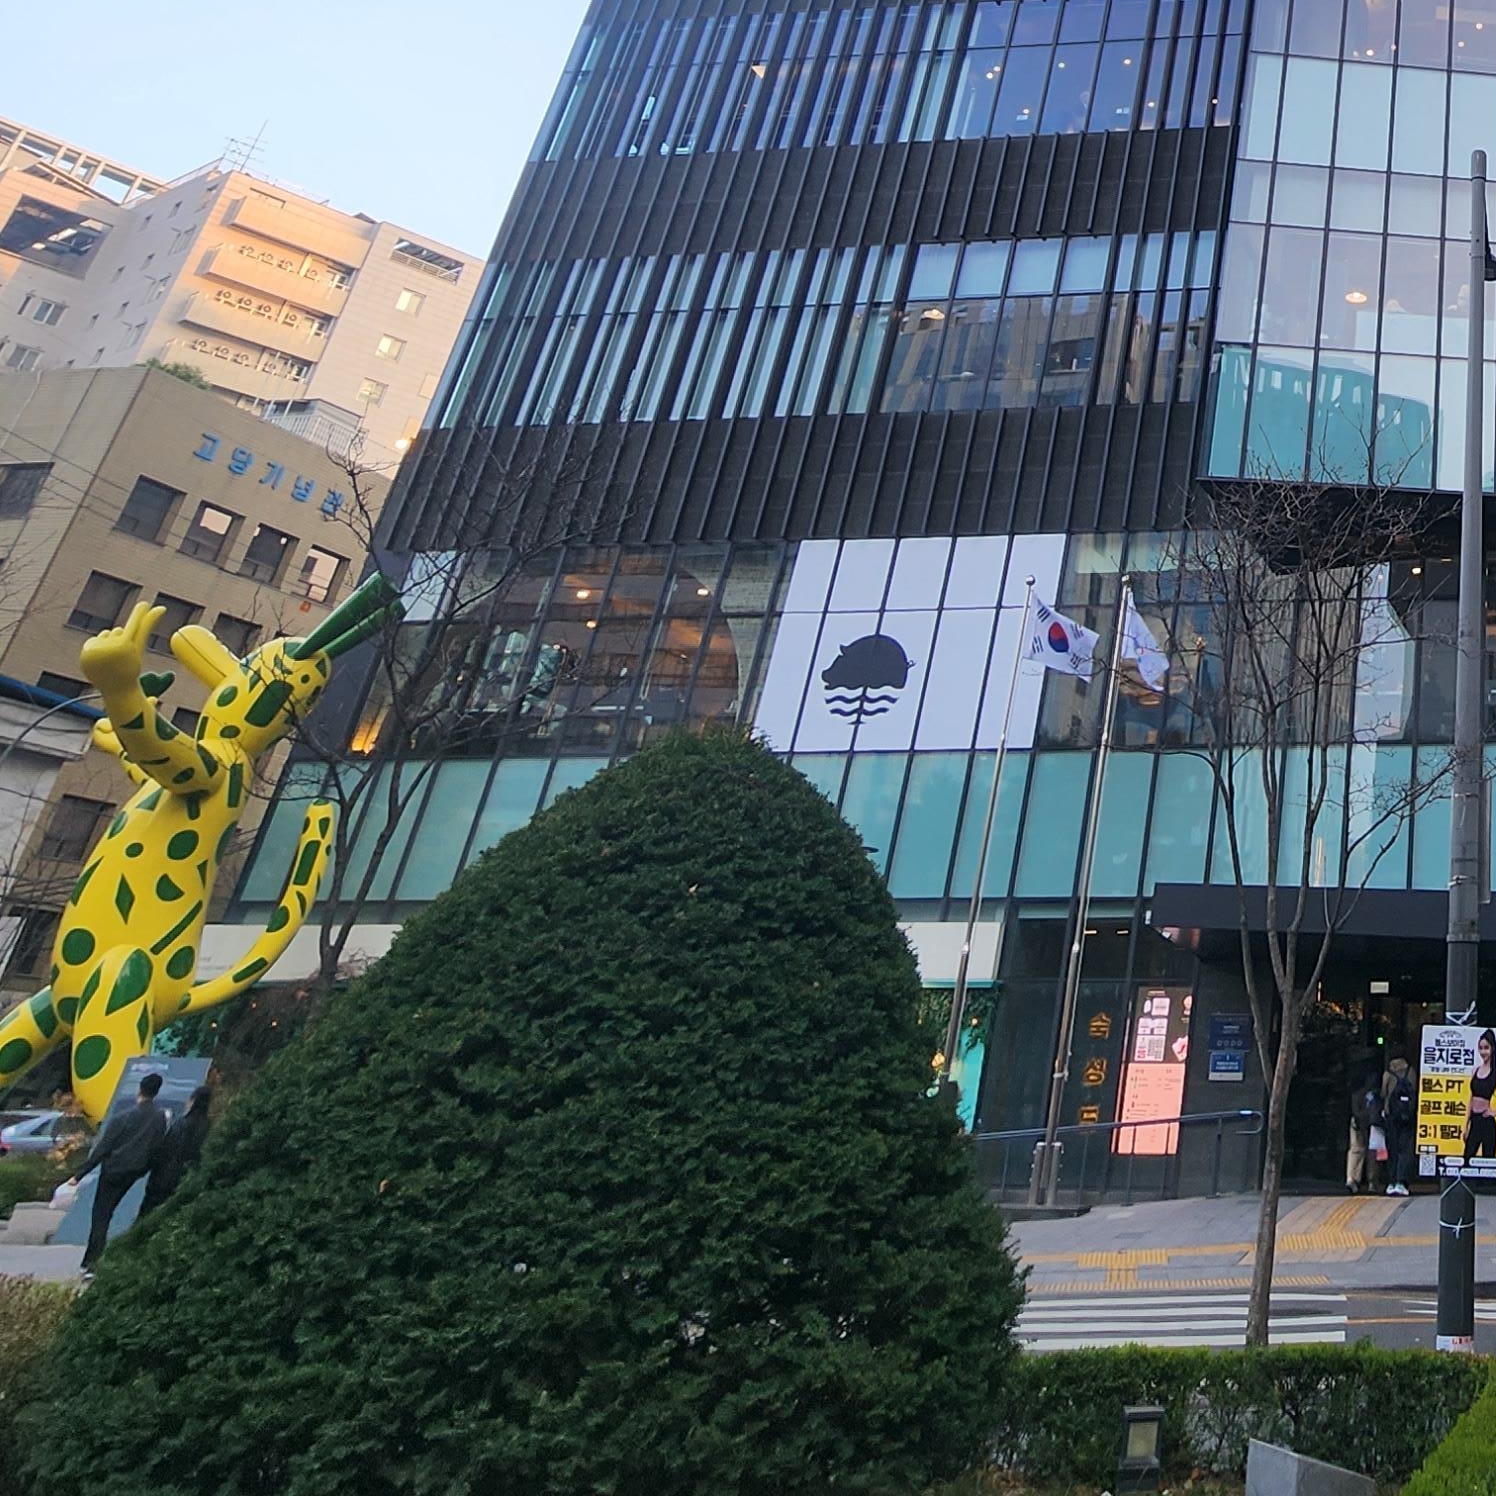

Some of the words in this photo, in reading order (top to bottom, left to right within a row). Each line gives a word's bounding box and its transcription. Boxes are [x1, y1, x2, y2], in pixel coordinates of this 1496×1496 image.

[1424, 1046, 1475, 1066] 을지로점
[1422, 1078, 1443, 1093] 헬스
[1445, 1079, 1464, 1093] PT
[1420, 1100, 1442, 1115] 골프
[1444, 1100, 1466, 1116] 레슨
[1418, 1124, 1437, 1138] 3:1
